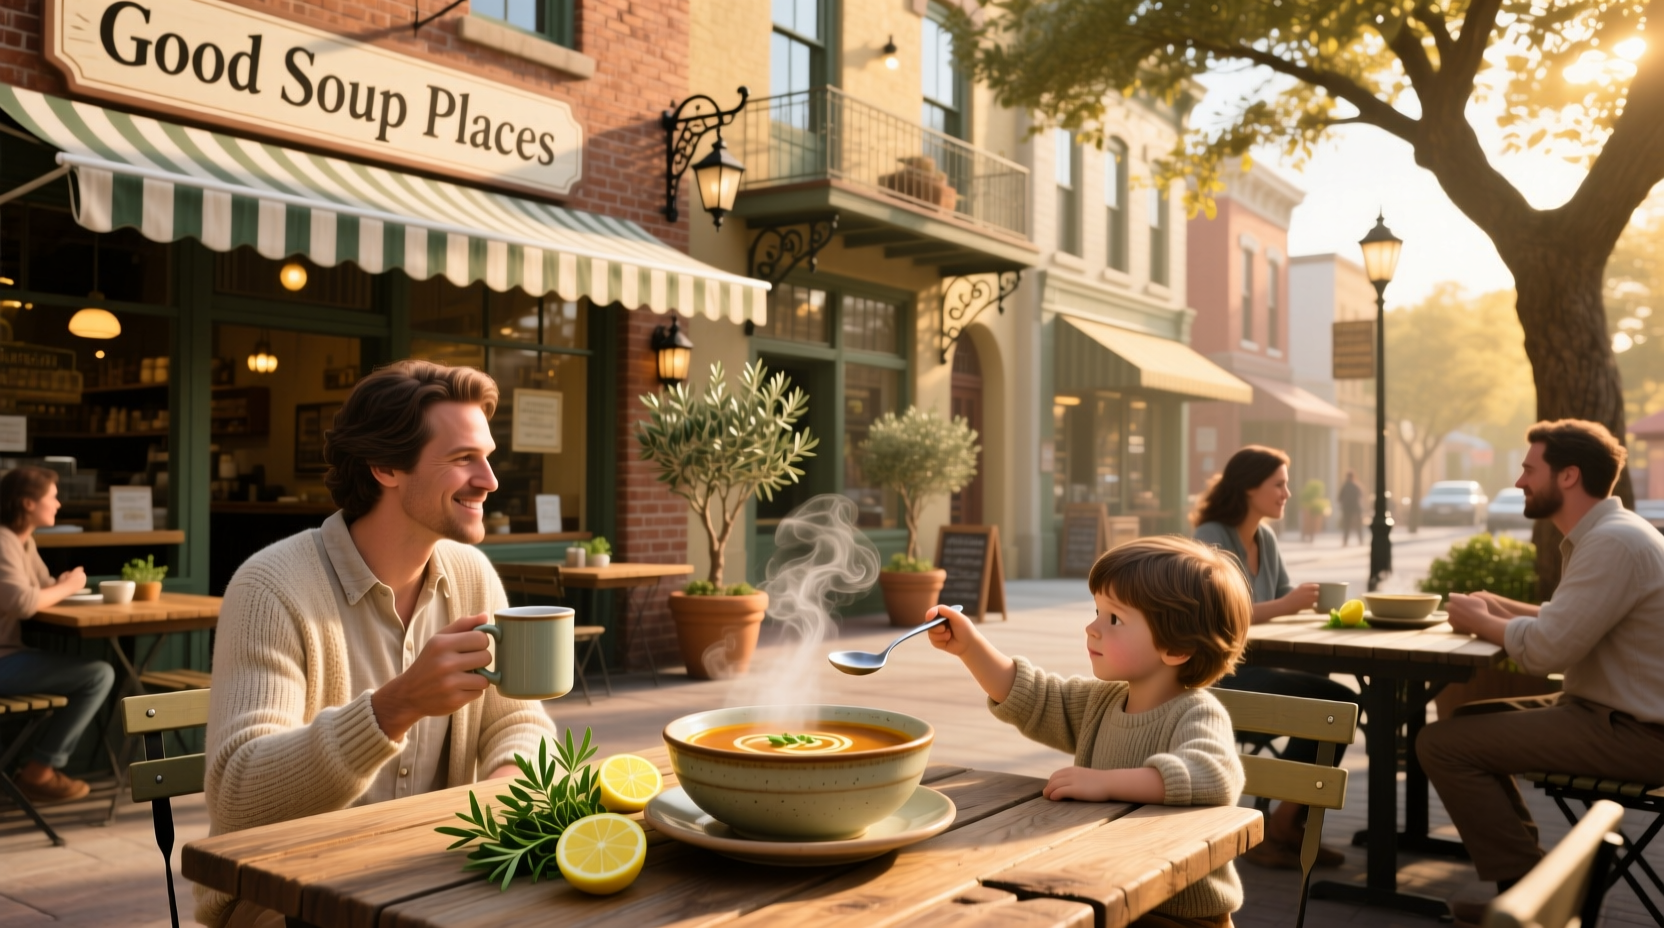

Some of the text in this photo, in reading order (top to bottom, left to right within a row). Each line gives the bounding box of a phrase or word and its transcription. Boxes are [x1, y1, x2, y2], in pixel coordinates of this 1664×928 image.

[99, 0, 555, 166] Good Soup Places
